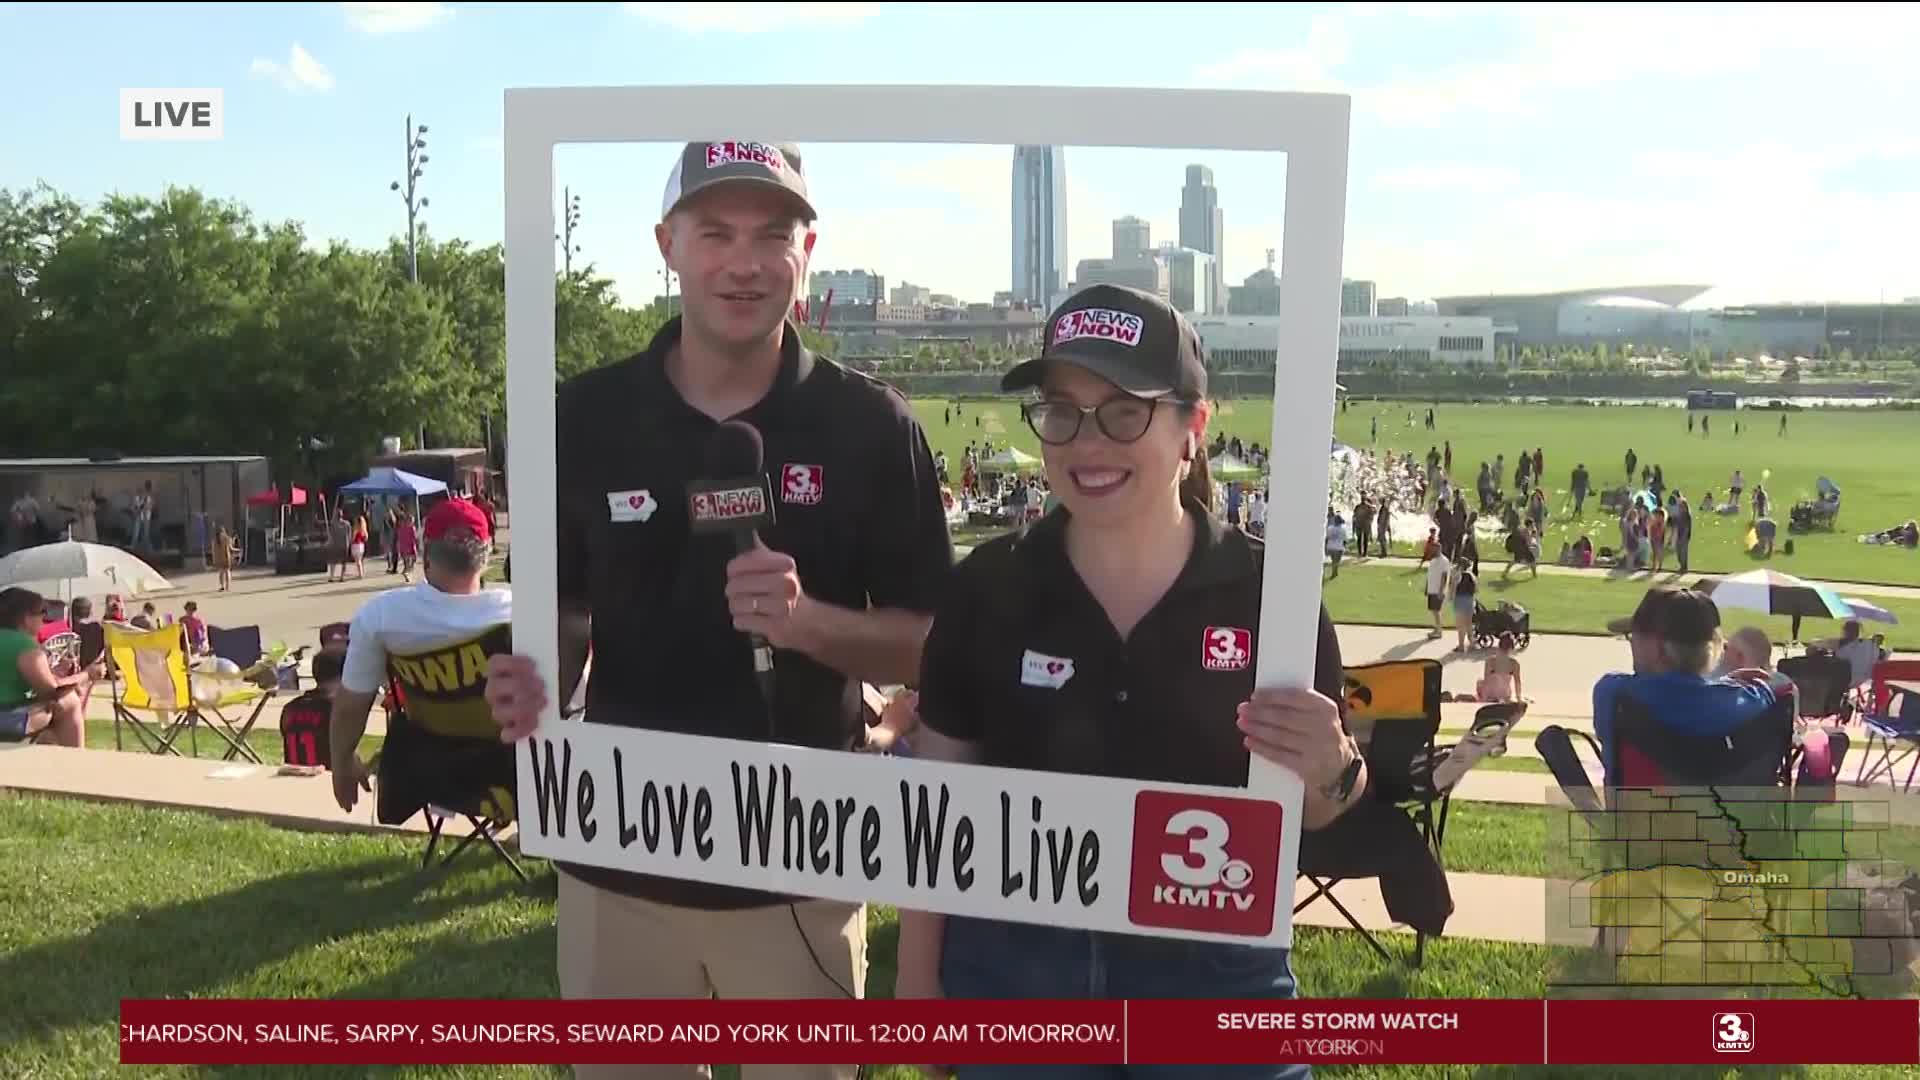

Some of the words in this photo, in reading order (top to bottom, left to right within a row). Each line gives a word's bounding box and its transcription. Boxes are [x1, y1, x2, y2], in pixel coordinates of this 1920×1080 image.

[736, 142, 778, 157] NEW
[1057, 317, 1073, 337] 3
[1083, 310, 1139, 329] NEWS
[1079, 324, 1136, 342] NOW
[787, 465, 812, 494] 3
[695, 494, 709, 513] 3
[719, 488, 761, 504] NEWS
[784, 492, 820, 504] KMTV
[719, 501, 761, 517] NOW
[1208, 628, 1237, 660] 3
[1206, 658, 1247, 669] KMTV
[529, 736, 598, 843] We
[613, 746, 714, 861] Love
[731, 760, 882, 881] Where
[900, 779, 975, 892] We
[1001, 790, 1101, 907] Live
[1160, 808, 1230, 887] 3
[1152, 884, 1256, 911] KMTV
